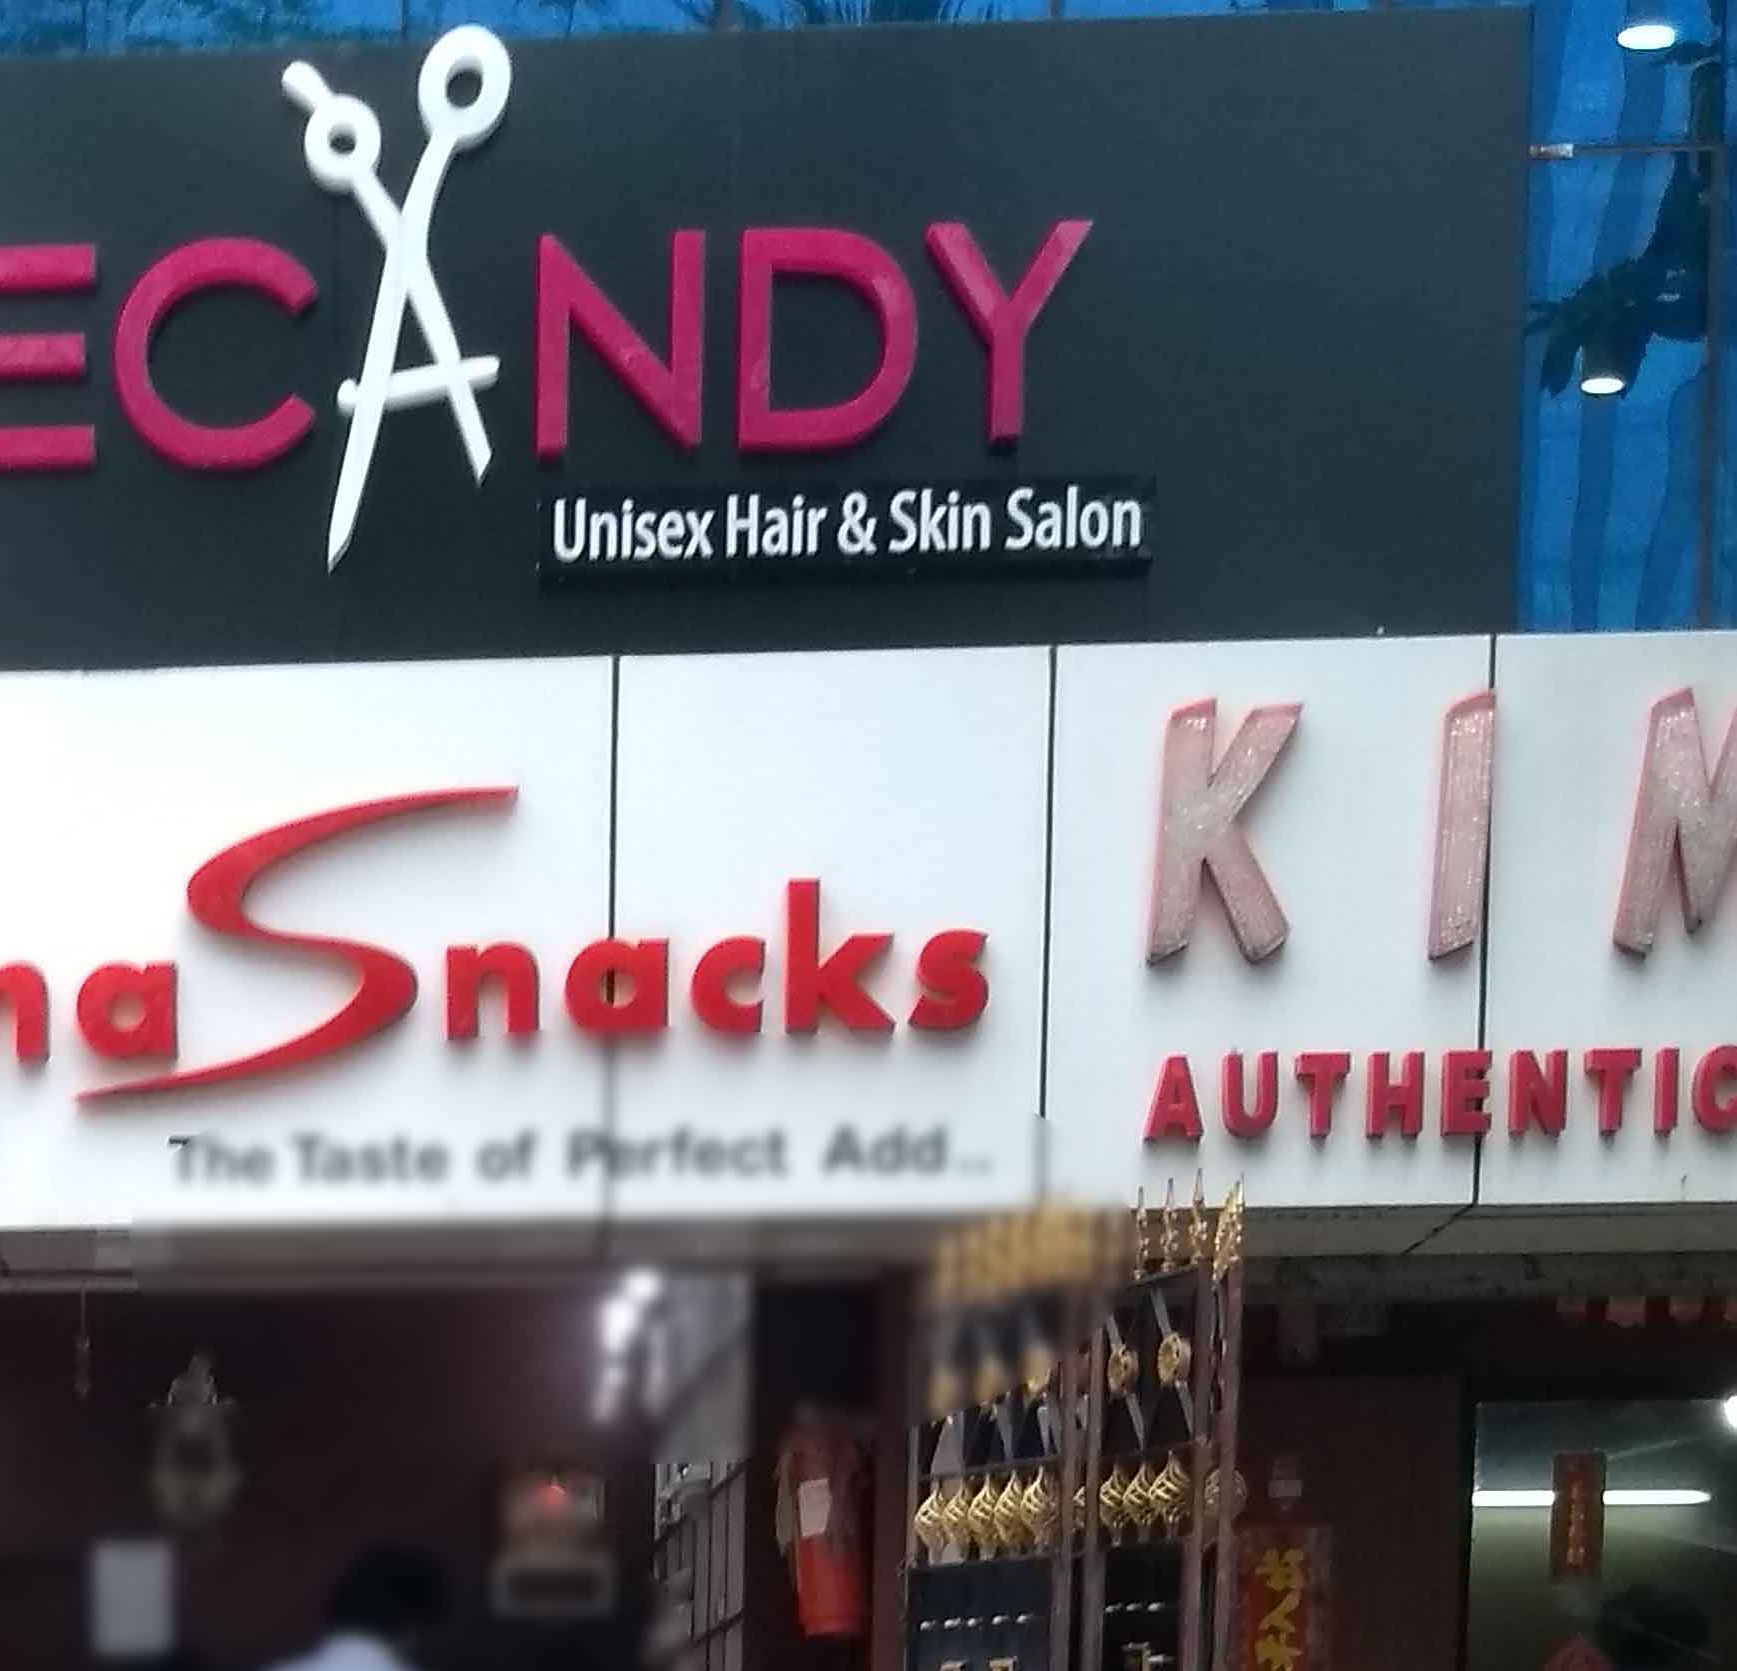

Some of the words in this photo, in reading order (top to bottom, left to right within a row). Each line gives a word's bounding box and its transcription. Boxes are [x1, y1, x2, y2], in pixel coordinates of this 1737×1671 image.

[552, 499, 715, 561] Unisex
[725, 495, 827, 558] Hair
[836, 491, 877, 555] &
[888, 489, 991, 552] Skin
[1004, 486, 1141, 549] Salon
[74, 785, 990, 1105] Snacks
[1143, 1045, 1737, 1143] AUTHENTIC
[170, 1133, 275, 1187] The
[294, 1132, 450, 1184] Taste
[476, 1129, 537, 1181] of
[566, 1126, 788, 1182] Perfect
